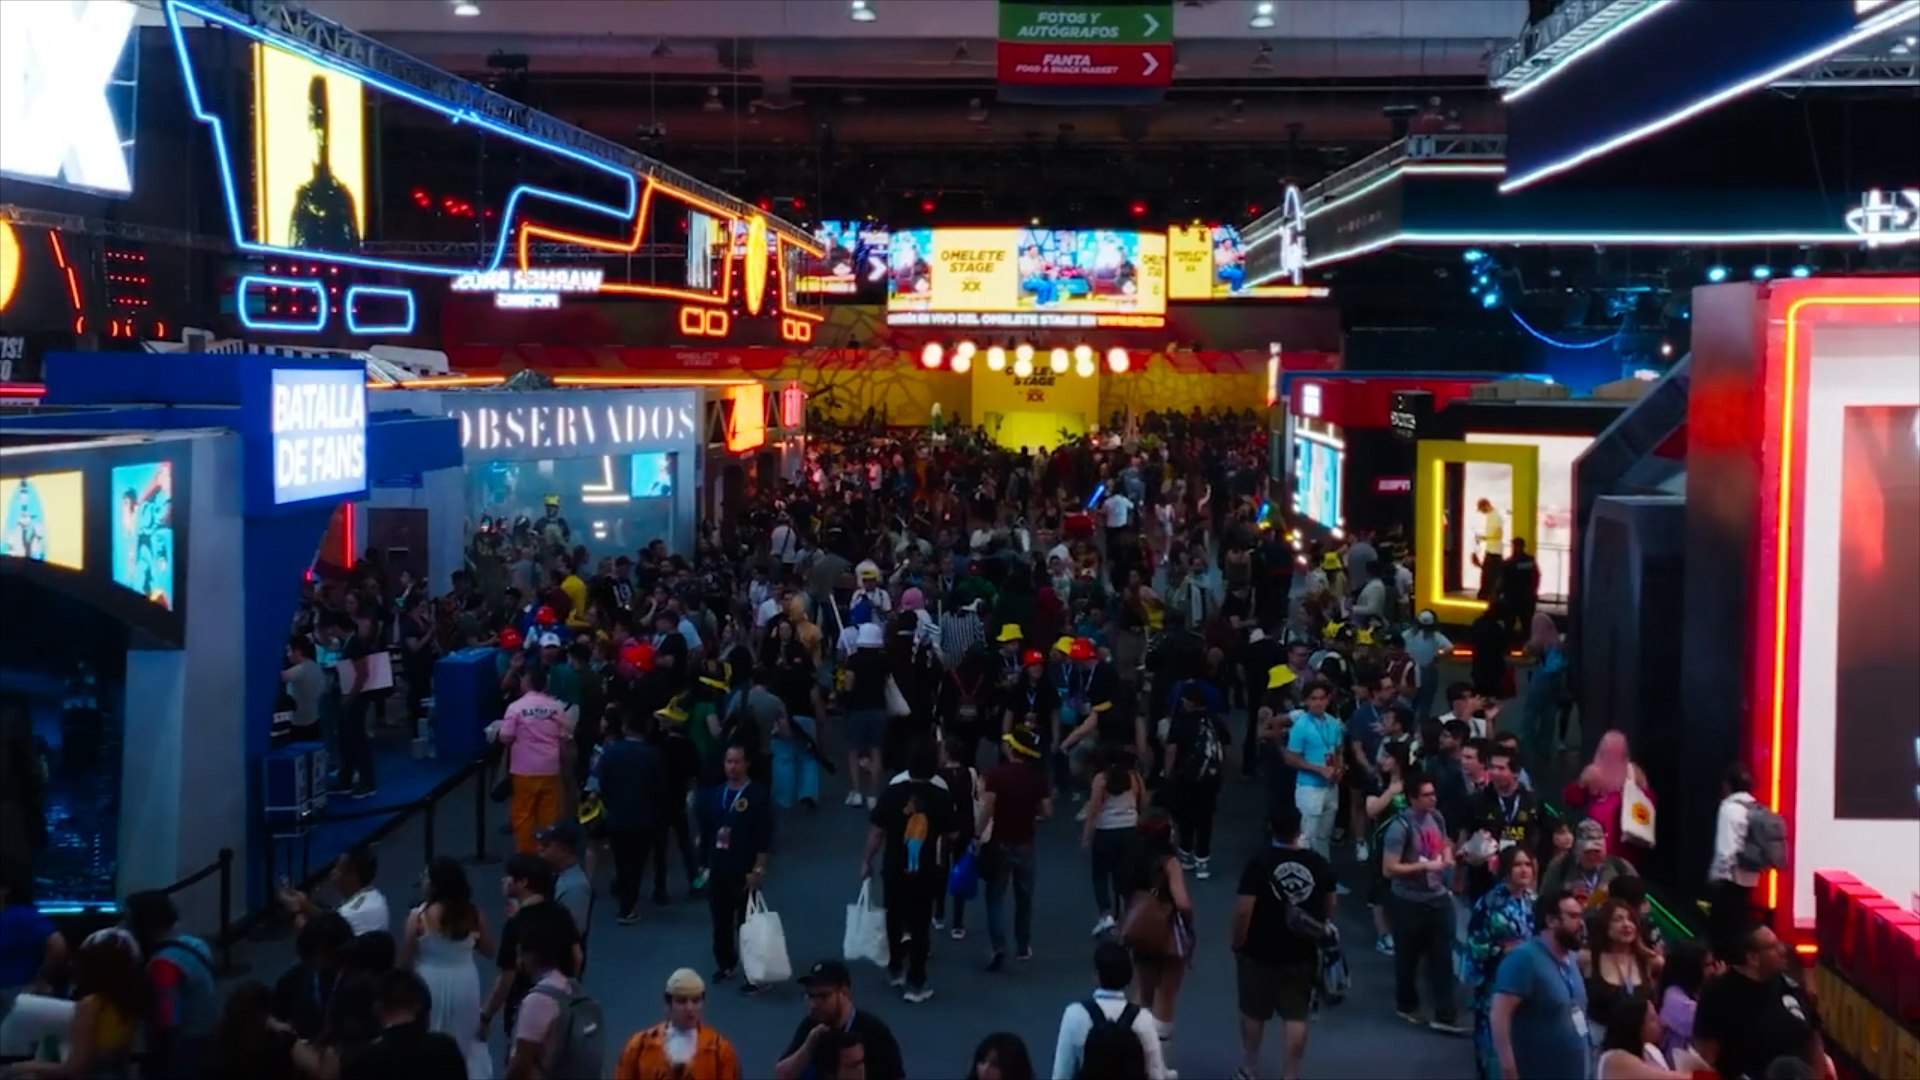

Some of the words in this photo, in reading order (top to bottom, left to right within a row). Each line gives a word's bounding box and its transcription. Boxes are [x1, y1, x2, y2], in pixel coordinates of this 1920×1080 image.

[1037, 11, 1087, 24] FOTOS
[1090, 12, 1102, 24] Y
[1016, 24, 1120, 39] AUTÓGRAFOS
[1042, 53, 1092, 66] FANTA
[1015, 64, 1042, 73] FOOD
[1081, 66, 1119, 75] MARKET
[941, 250, 1006, 261] OMELETE
[950, 262, 994, 273] STAGE
[1013, 377, 1056, 386] STAGE
[273, 383, 364, 433] BATALLA
[277, 437, 309, 489] DE
[311, 433, 365, 484] FANS
